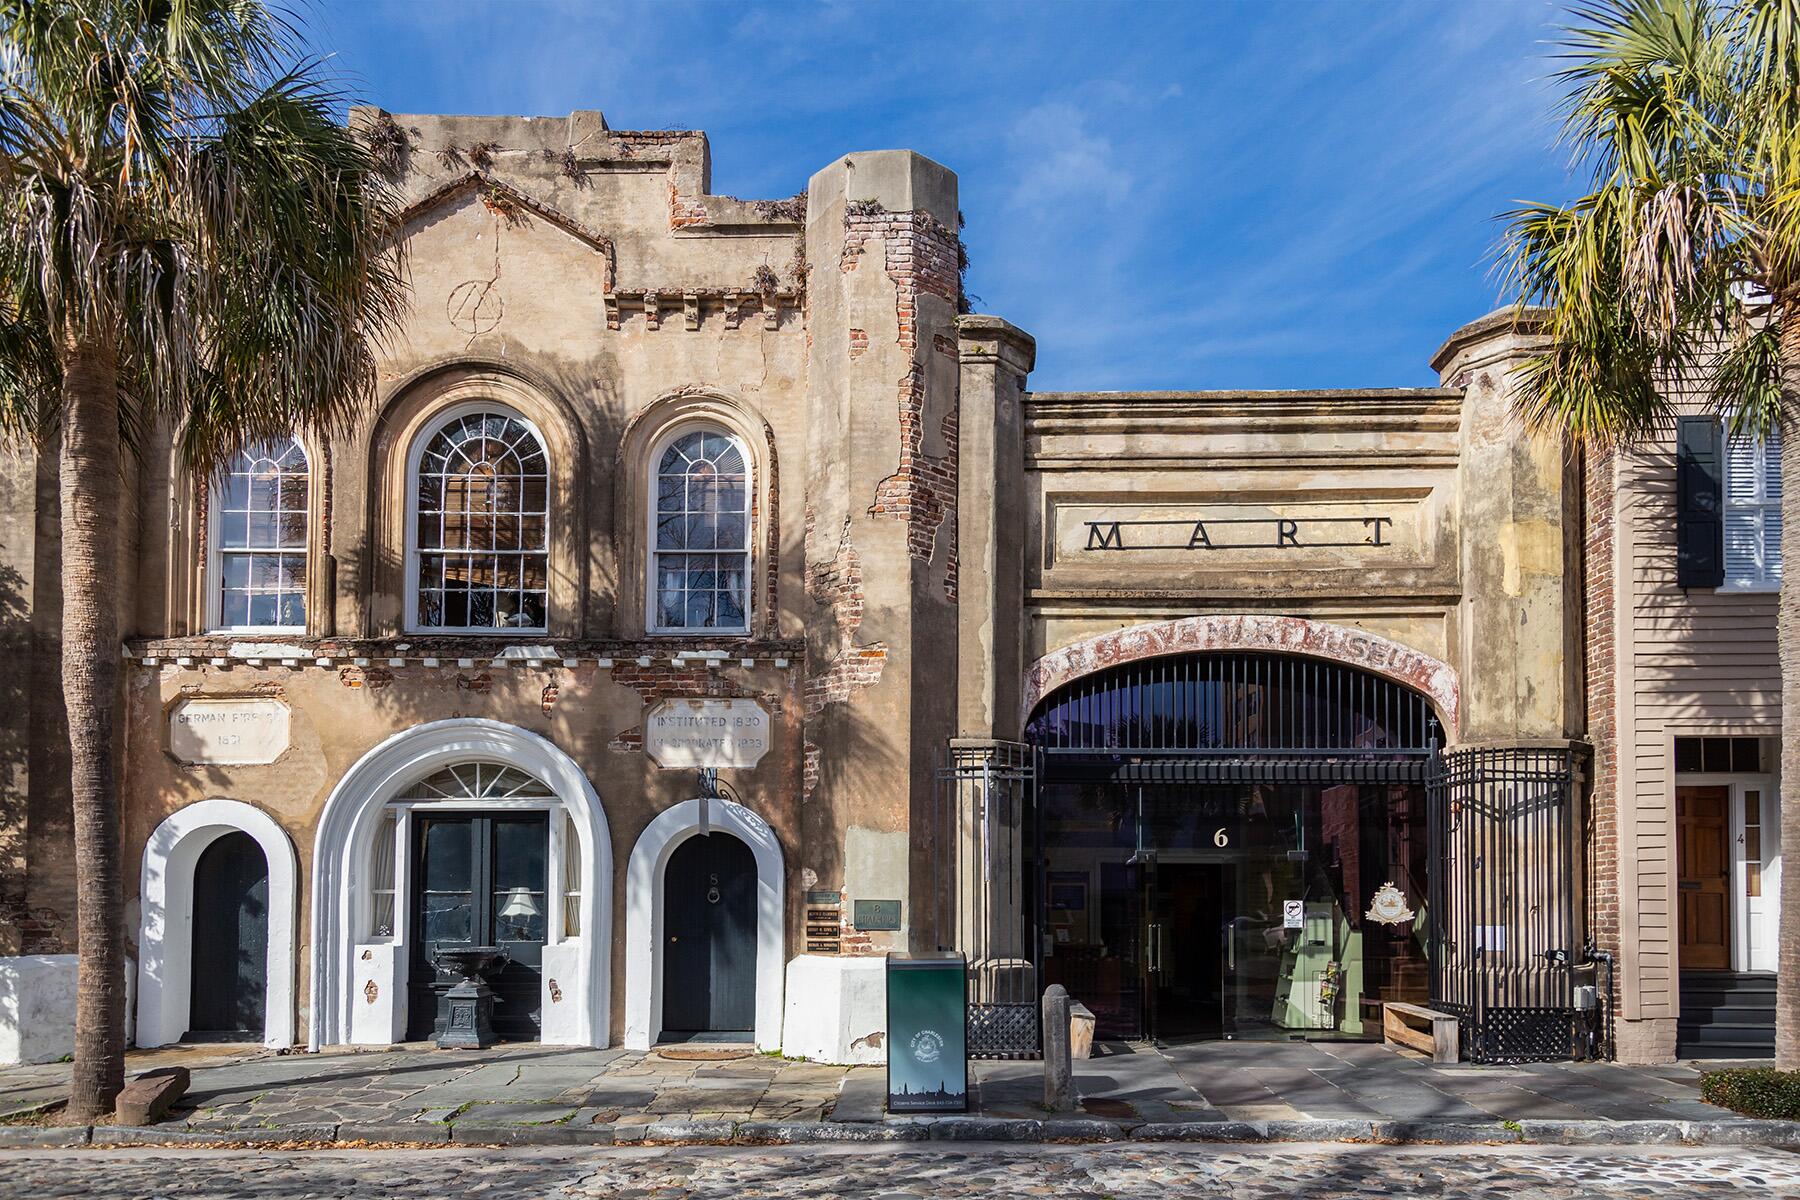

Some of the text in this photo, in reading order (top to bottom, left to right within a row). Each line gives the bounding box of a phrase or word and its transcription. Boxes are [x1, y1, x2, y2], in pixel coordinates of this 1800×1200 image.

[1086, 517, 1393, 550] MART
[178, 713, 225, 723] GERMAN
[657, 717, 727, 728] INSTITUTED
[1213, 827, 1229, 848] 6
[1737, 833, 1745, 844] 4
[710, 873, 719, 886] 8
